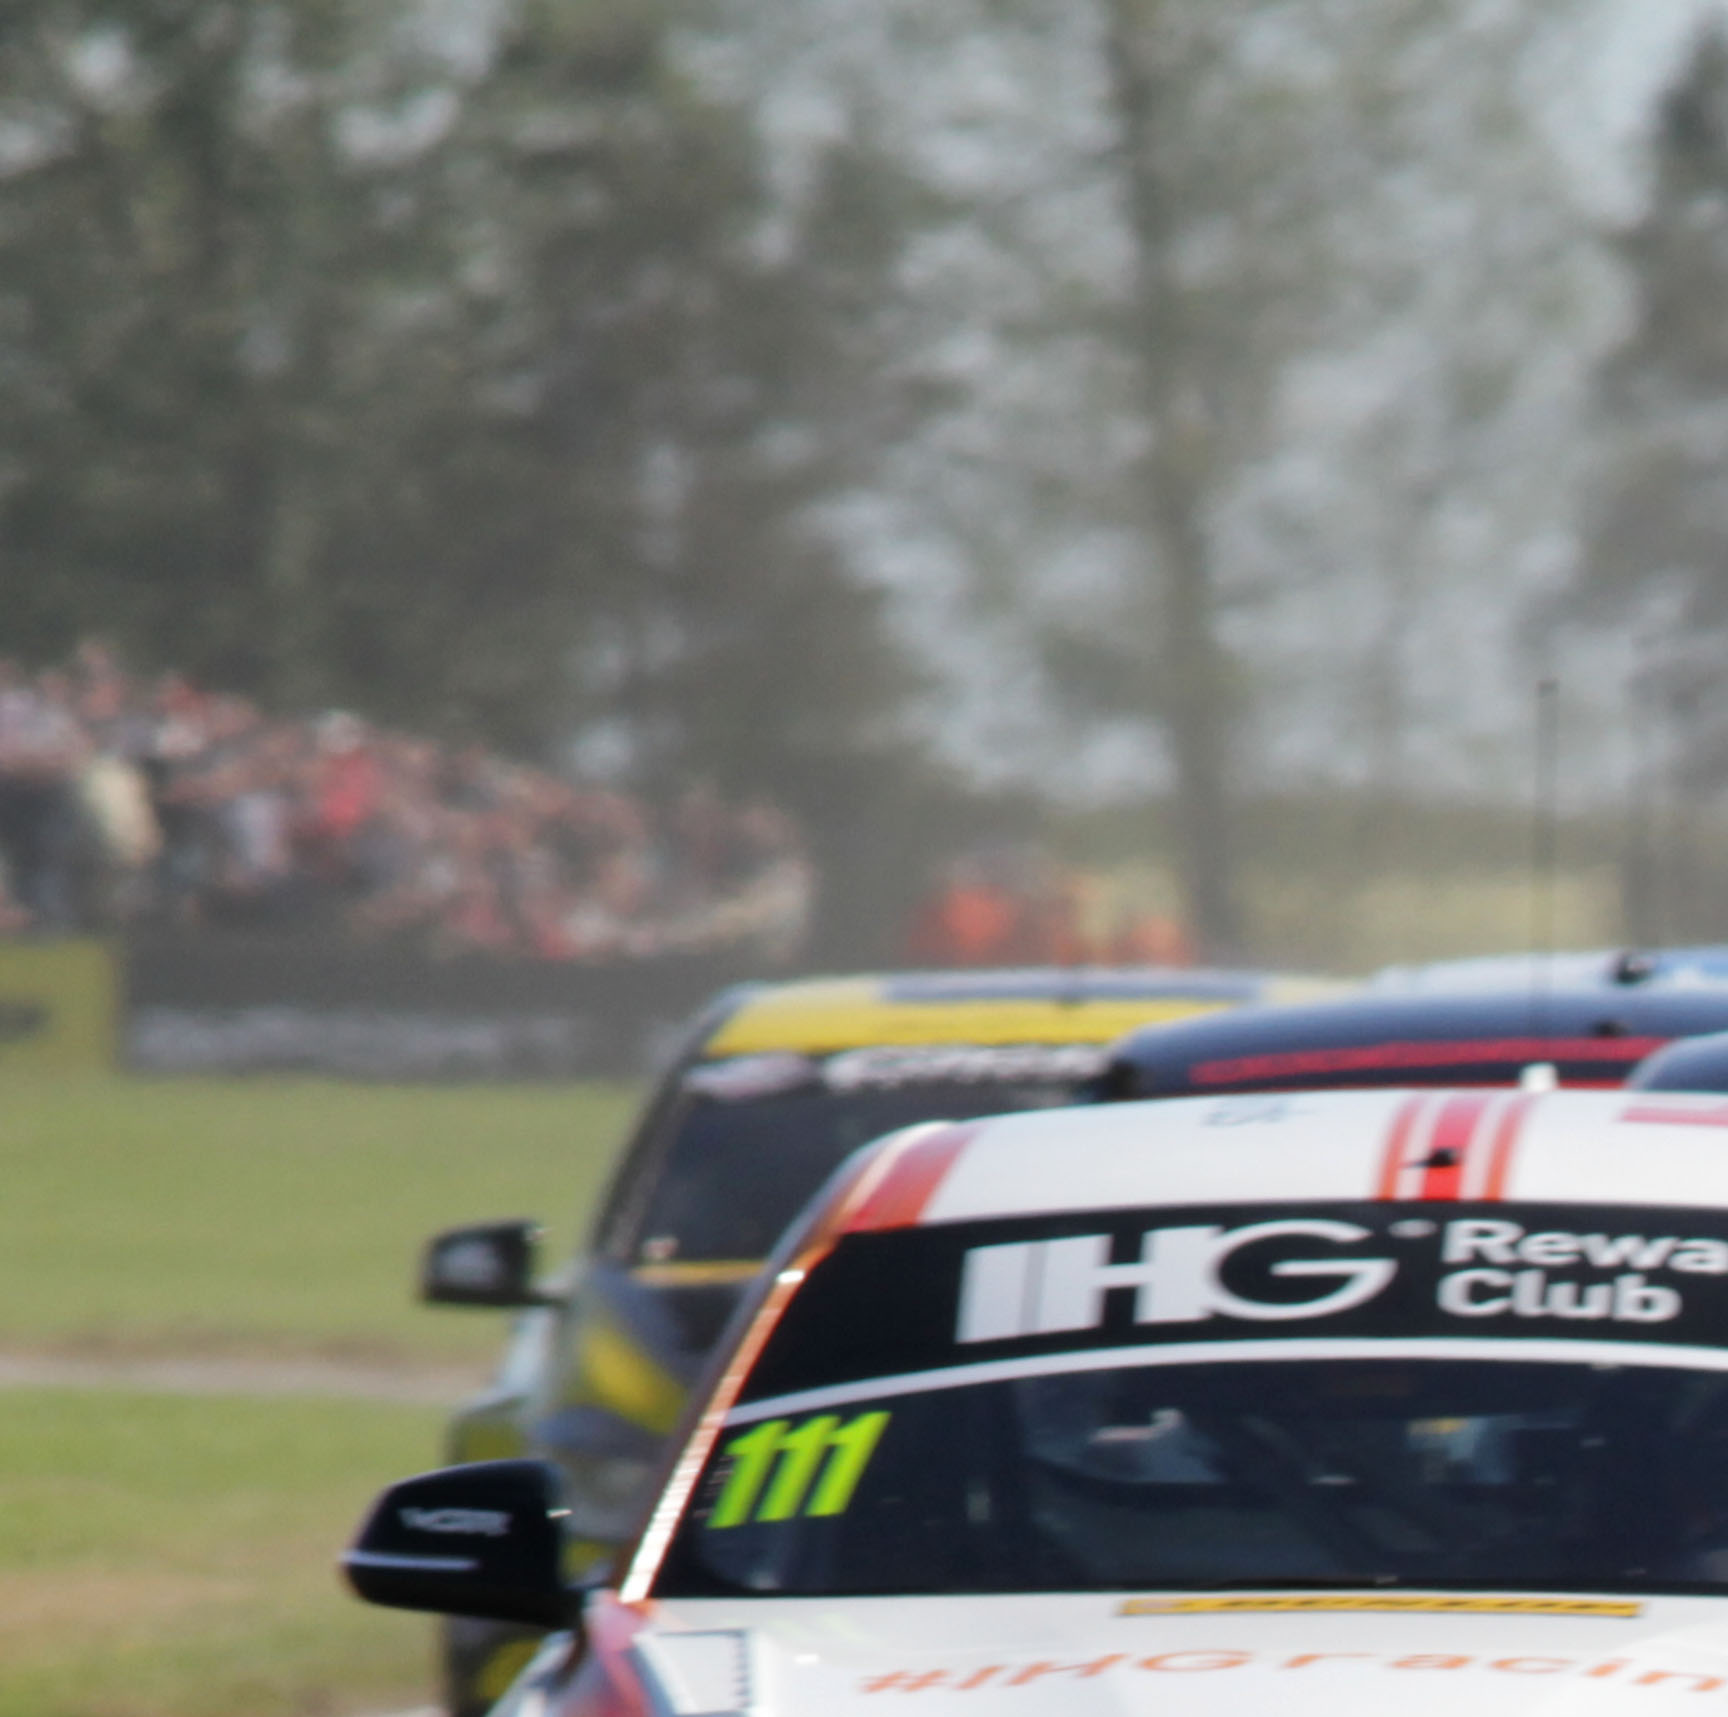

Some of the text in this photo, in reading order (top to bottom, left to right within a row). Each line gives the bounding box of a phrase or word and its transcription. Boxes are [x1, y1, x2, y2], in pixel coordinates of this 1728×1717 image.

[955, 1219, 1396, 1344] IHG
[1436, 1268, 1682, 1323] Club
[706, 1411, 891, 1529] 111
